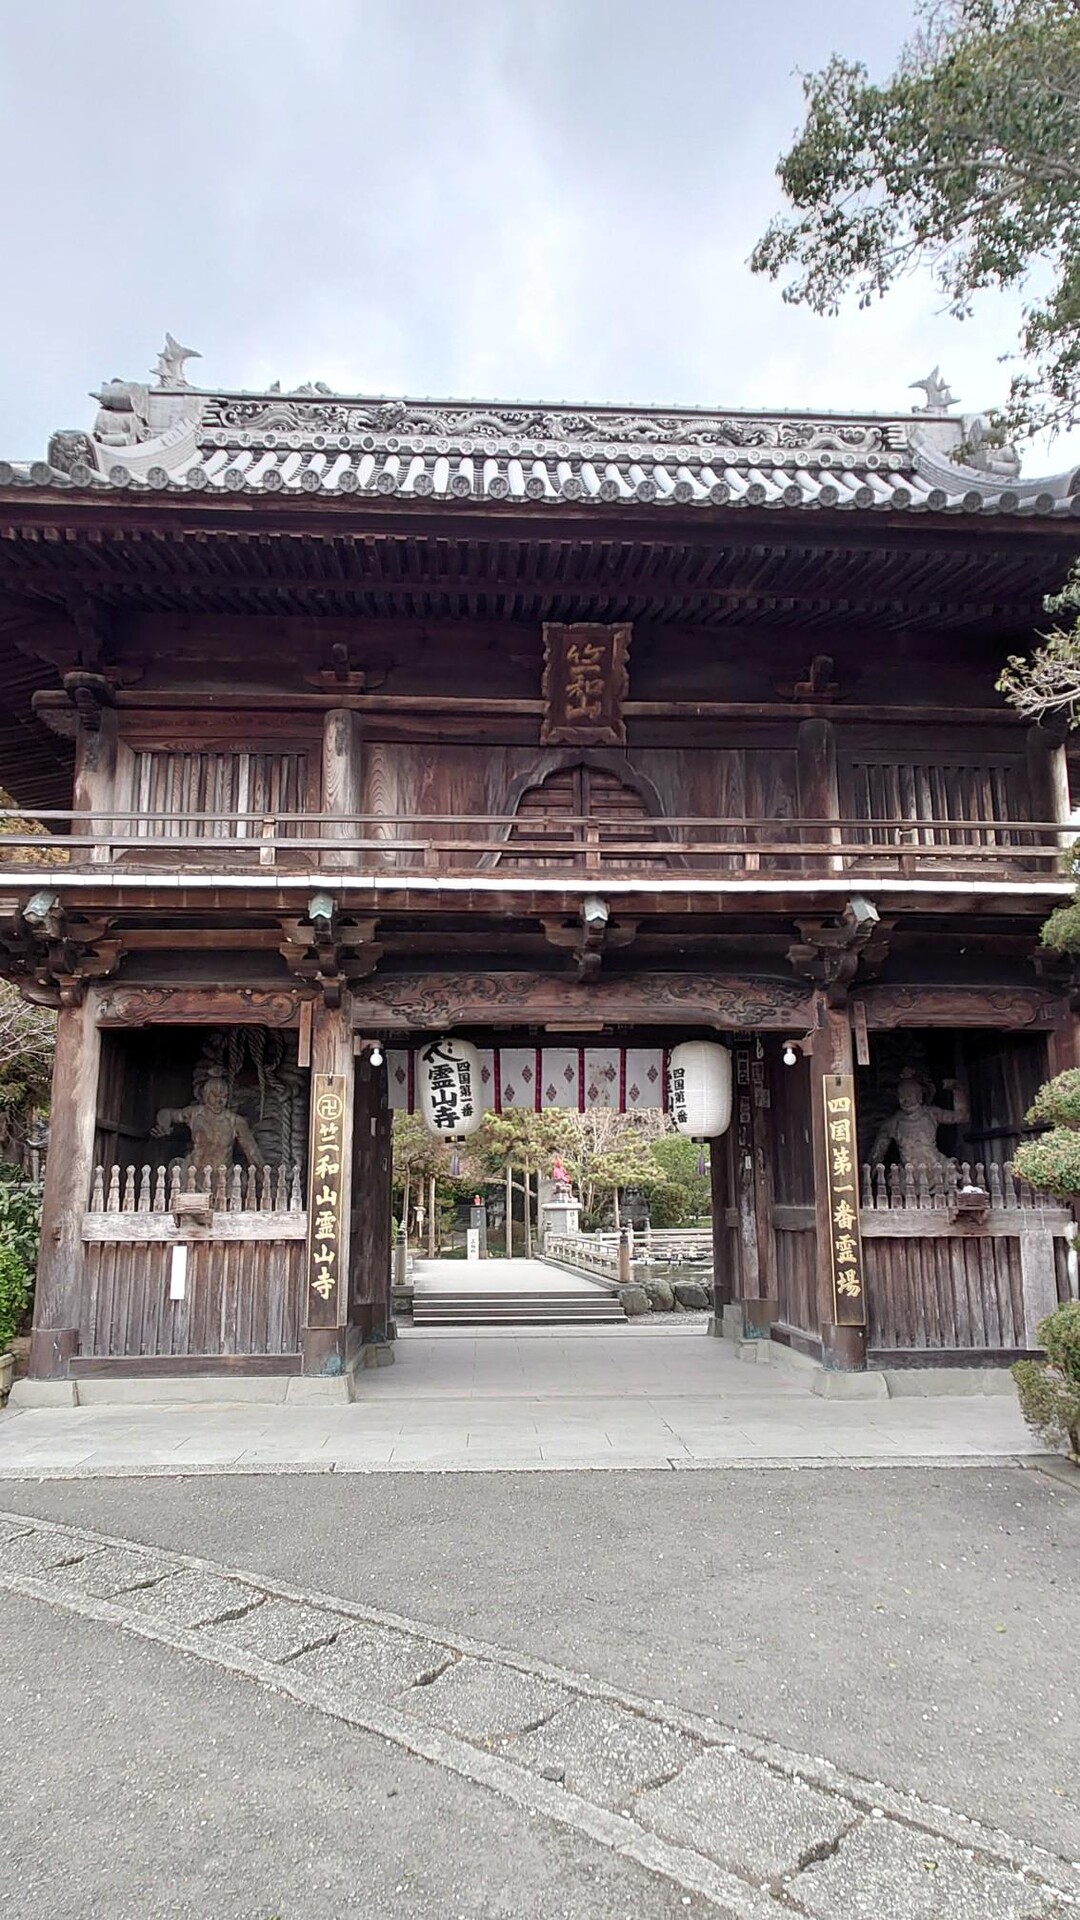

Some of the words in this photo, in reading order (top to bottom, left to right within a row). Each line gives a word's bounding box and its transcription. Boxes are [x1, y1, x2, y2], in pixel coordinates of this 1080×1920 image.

[565, 643, 606, 720] 竺和山
[457, 1061, 475, 1117] 四国第一番
[673, 1067, 688, 1124] 四国第一番
[828, 1096, 862, 1298] 四国第一番霊場
